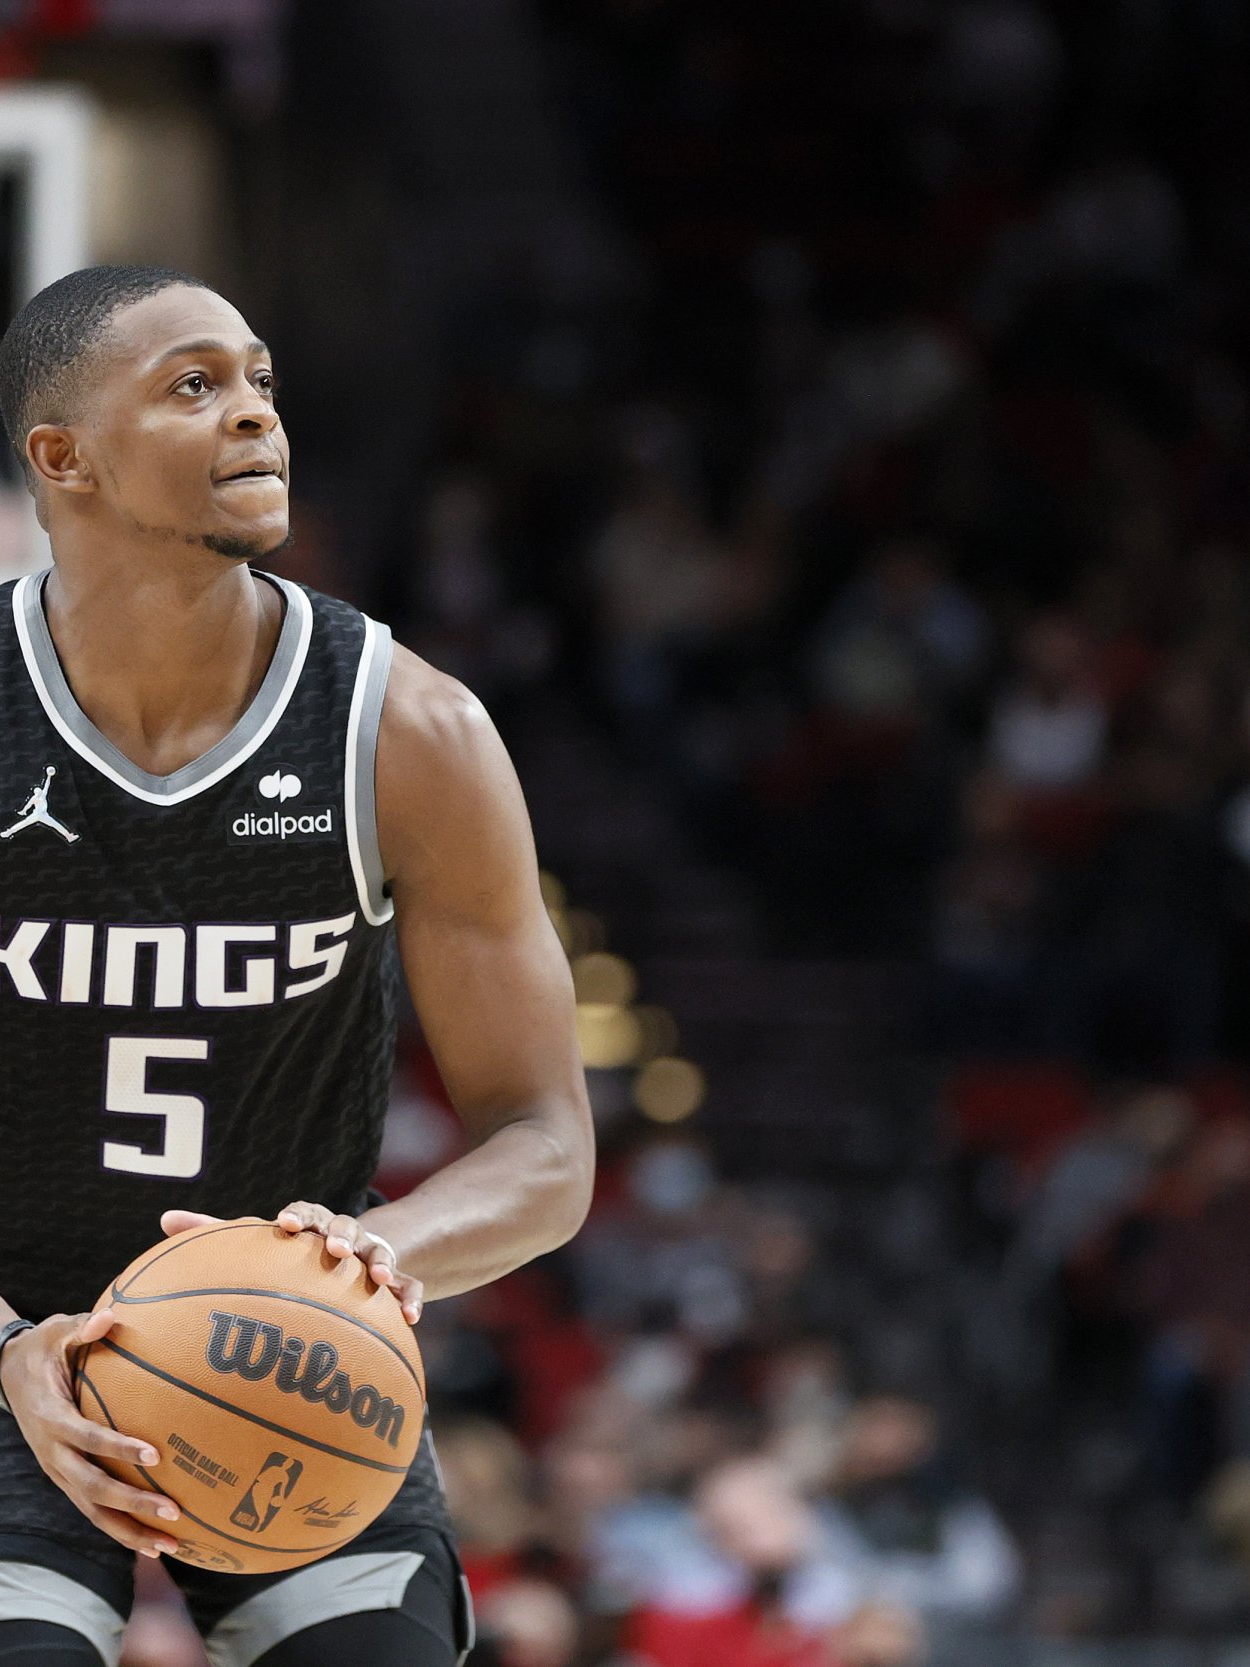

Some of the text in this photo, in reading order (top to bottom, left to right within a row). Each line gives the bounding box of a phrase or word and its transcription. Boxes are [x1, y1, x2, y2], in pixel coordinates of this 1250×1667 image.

[232, 808, 332, 840] dialpad
[102, 1036, 210, 1179] 5
[206, 1309, 405, 1450] Wilson
[167, 1432, 200, 1463] OFFICIAL
[197, 1455, 222, 1476] GAME
[218, 1468, 239, 1487] BALL
